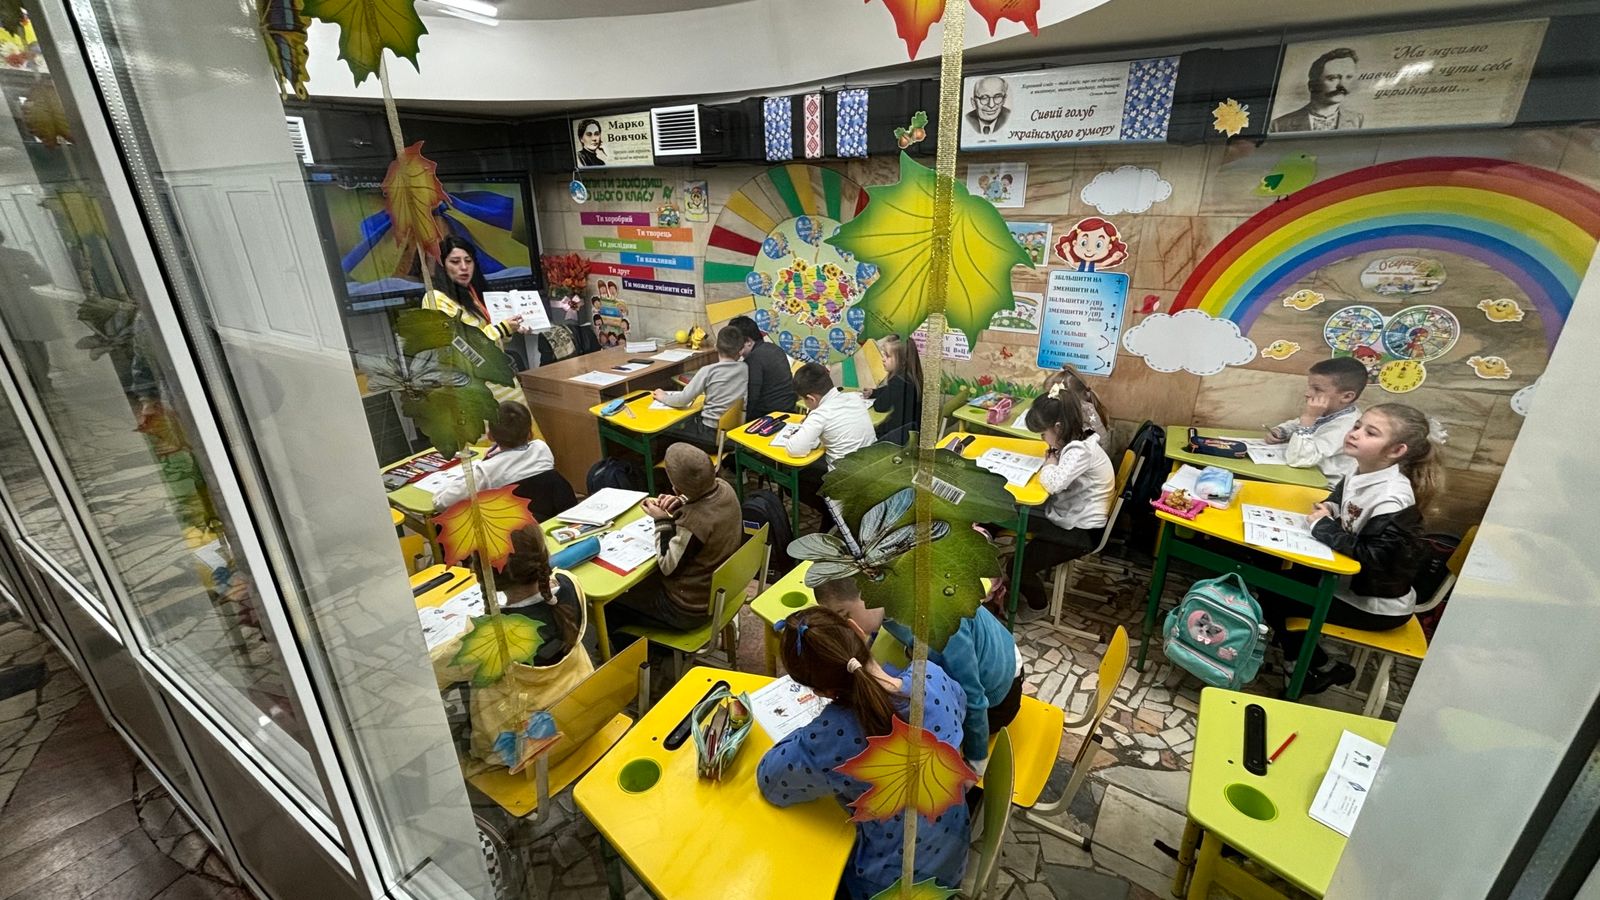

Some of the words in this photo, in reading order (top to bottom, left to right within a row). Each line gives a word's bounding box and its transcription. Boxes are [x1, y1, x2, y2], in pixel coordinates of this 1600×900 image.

[1429, 45, 1488, 58] мусимо
[1439, 62, 1480, 77] чути
[1482, 58, 1513, 72] себе
[1030, 106, 1062, 121] Сивий
[1065, 104, 1097, 121] голуб
[608, 120, 645, 130] Марко
[607, 132, 648, 143] Вовчок
[1008, 128, 1073, 141] українського
[1075, 125, 1115, 141] гумору
[616, 177, 663, 190] ЗАХОДИШ
[624, 189, 655, 201] КЛАСУ
[605, 215, 633, 225] хоробрий
[637, 228, 644, 237] Ти
[645, 230, 672, 238] творець
[599, 240, 606, 248] Ти
[645, 256, 677, 265] важливий
[608, 266, 617, 274] Ти
[618, 268, 631, 277] друг
[624, 280, 632, 288] Ти
[633, 282, 654, 290] можеш
[655, 284, 679, 293] змінити
[680, 286, 693, 295] світ
